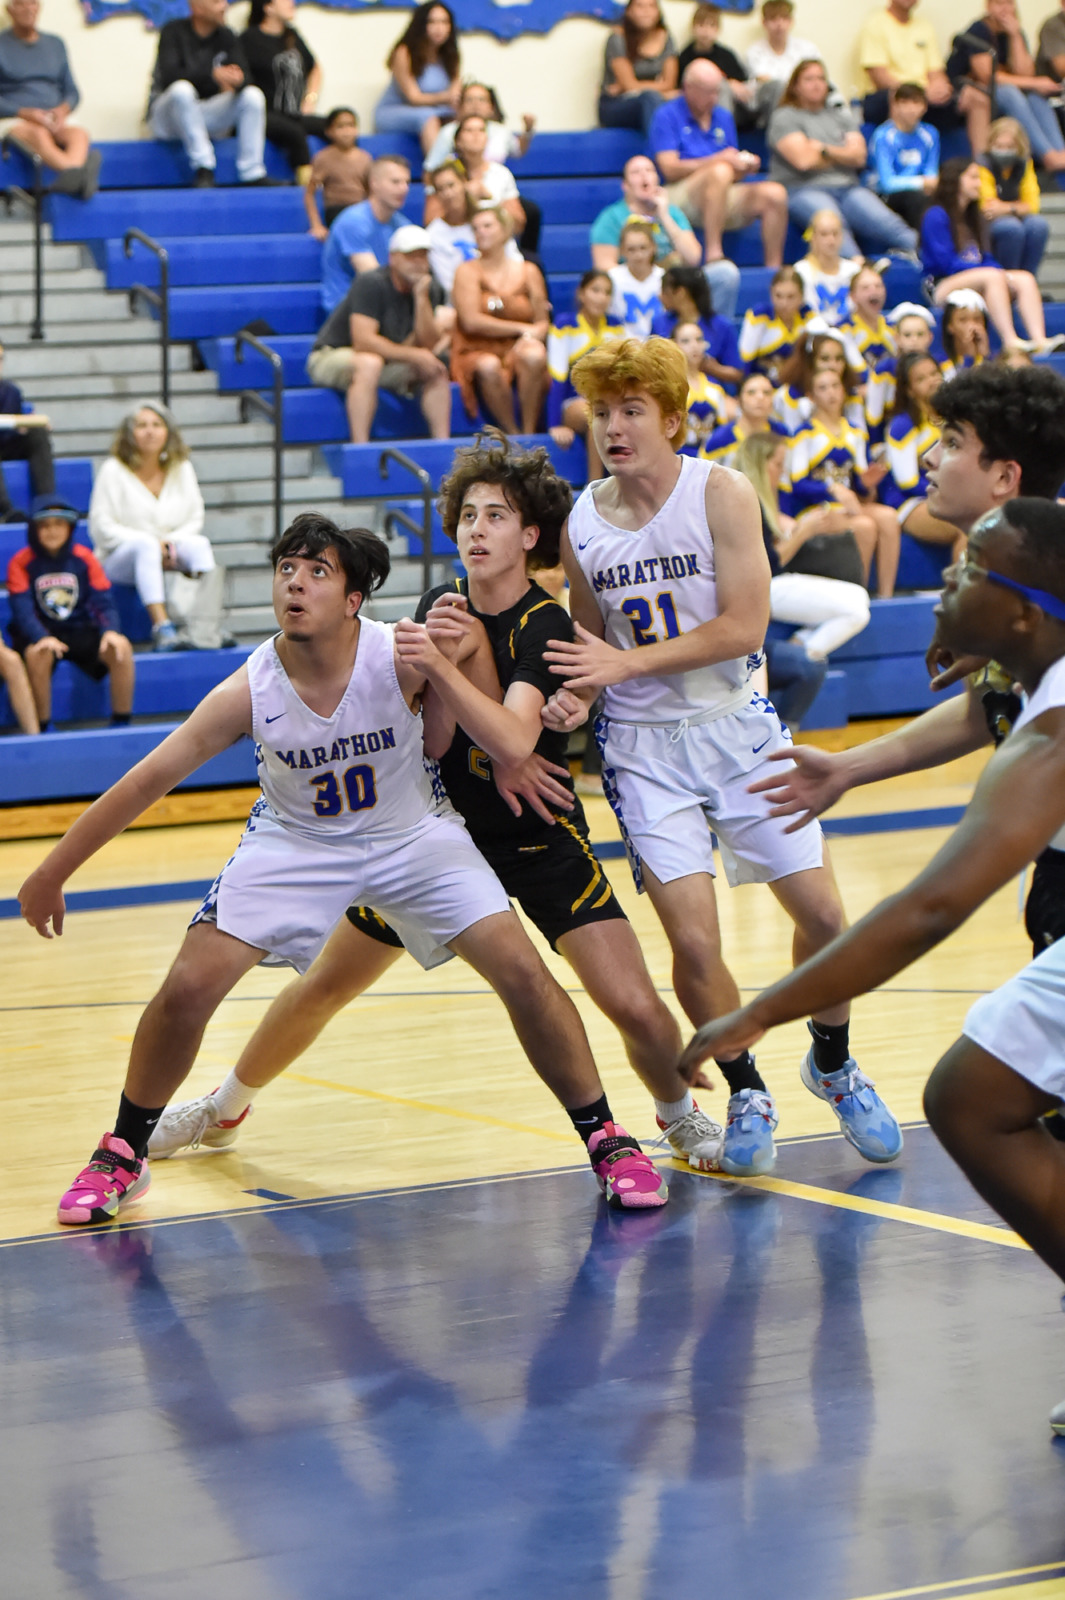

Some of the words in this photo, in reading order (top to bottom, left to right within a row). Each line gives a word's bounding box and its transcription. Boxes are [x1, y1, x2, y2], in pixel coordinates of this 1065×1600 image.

[592, 553, 701, 593] MARATHON
[620, 590, 685, 647] 21
[276, 727, 397, 769] MARATHON
[309, 763, 378, 818] 30
